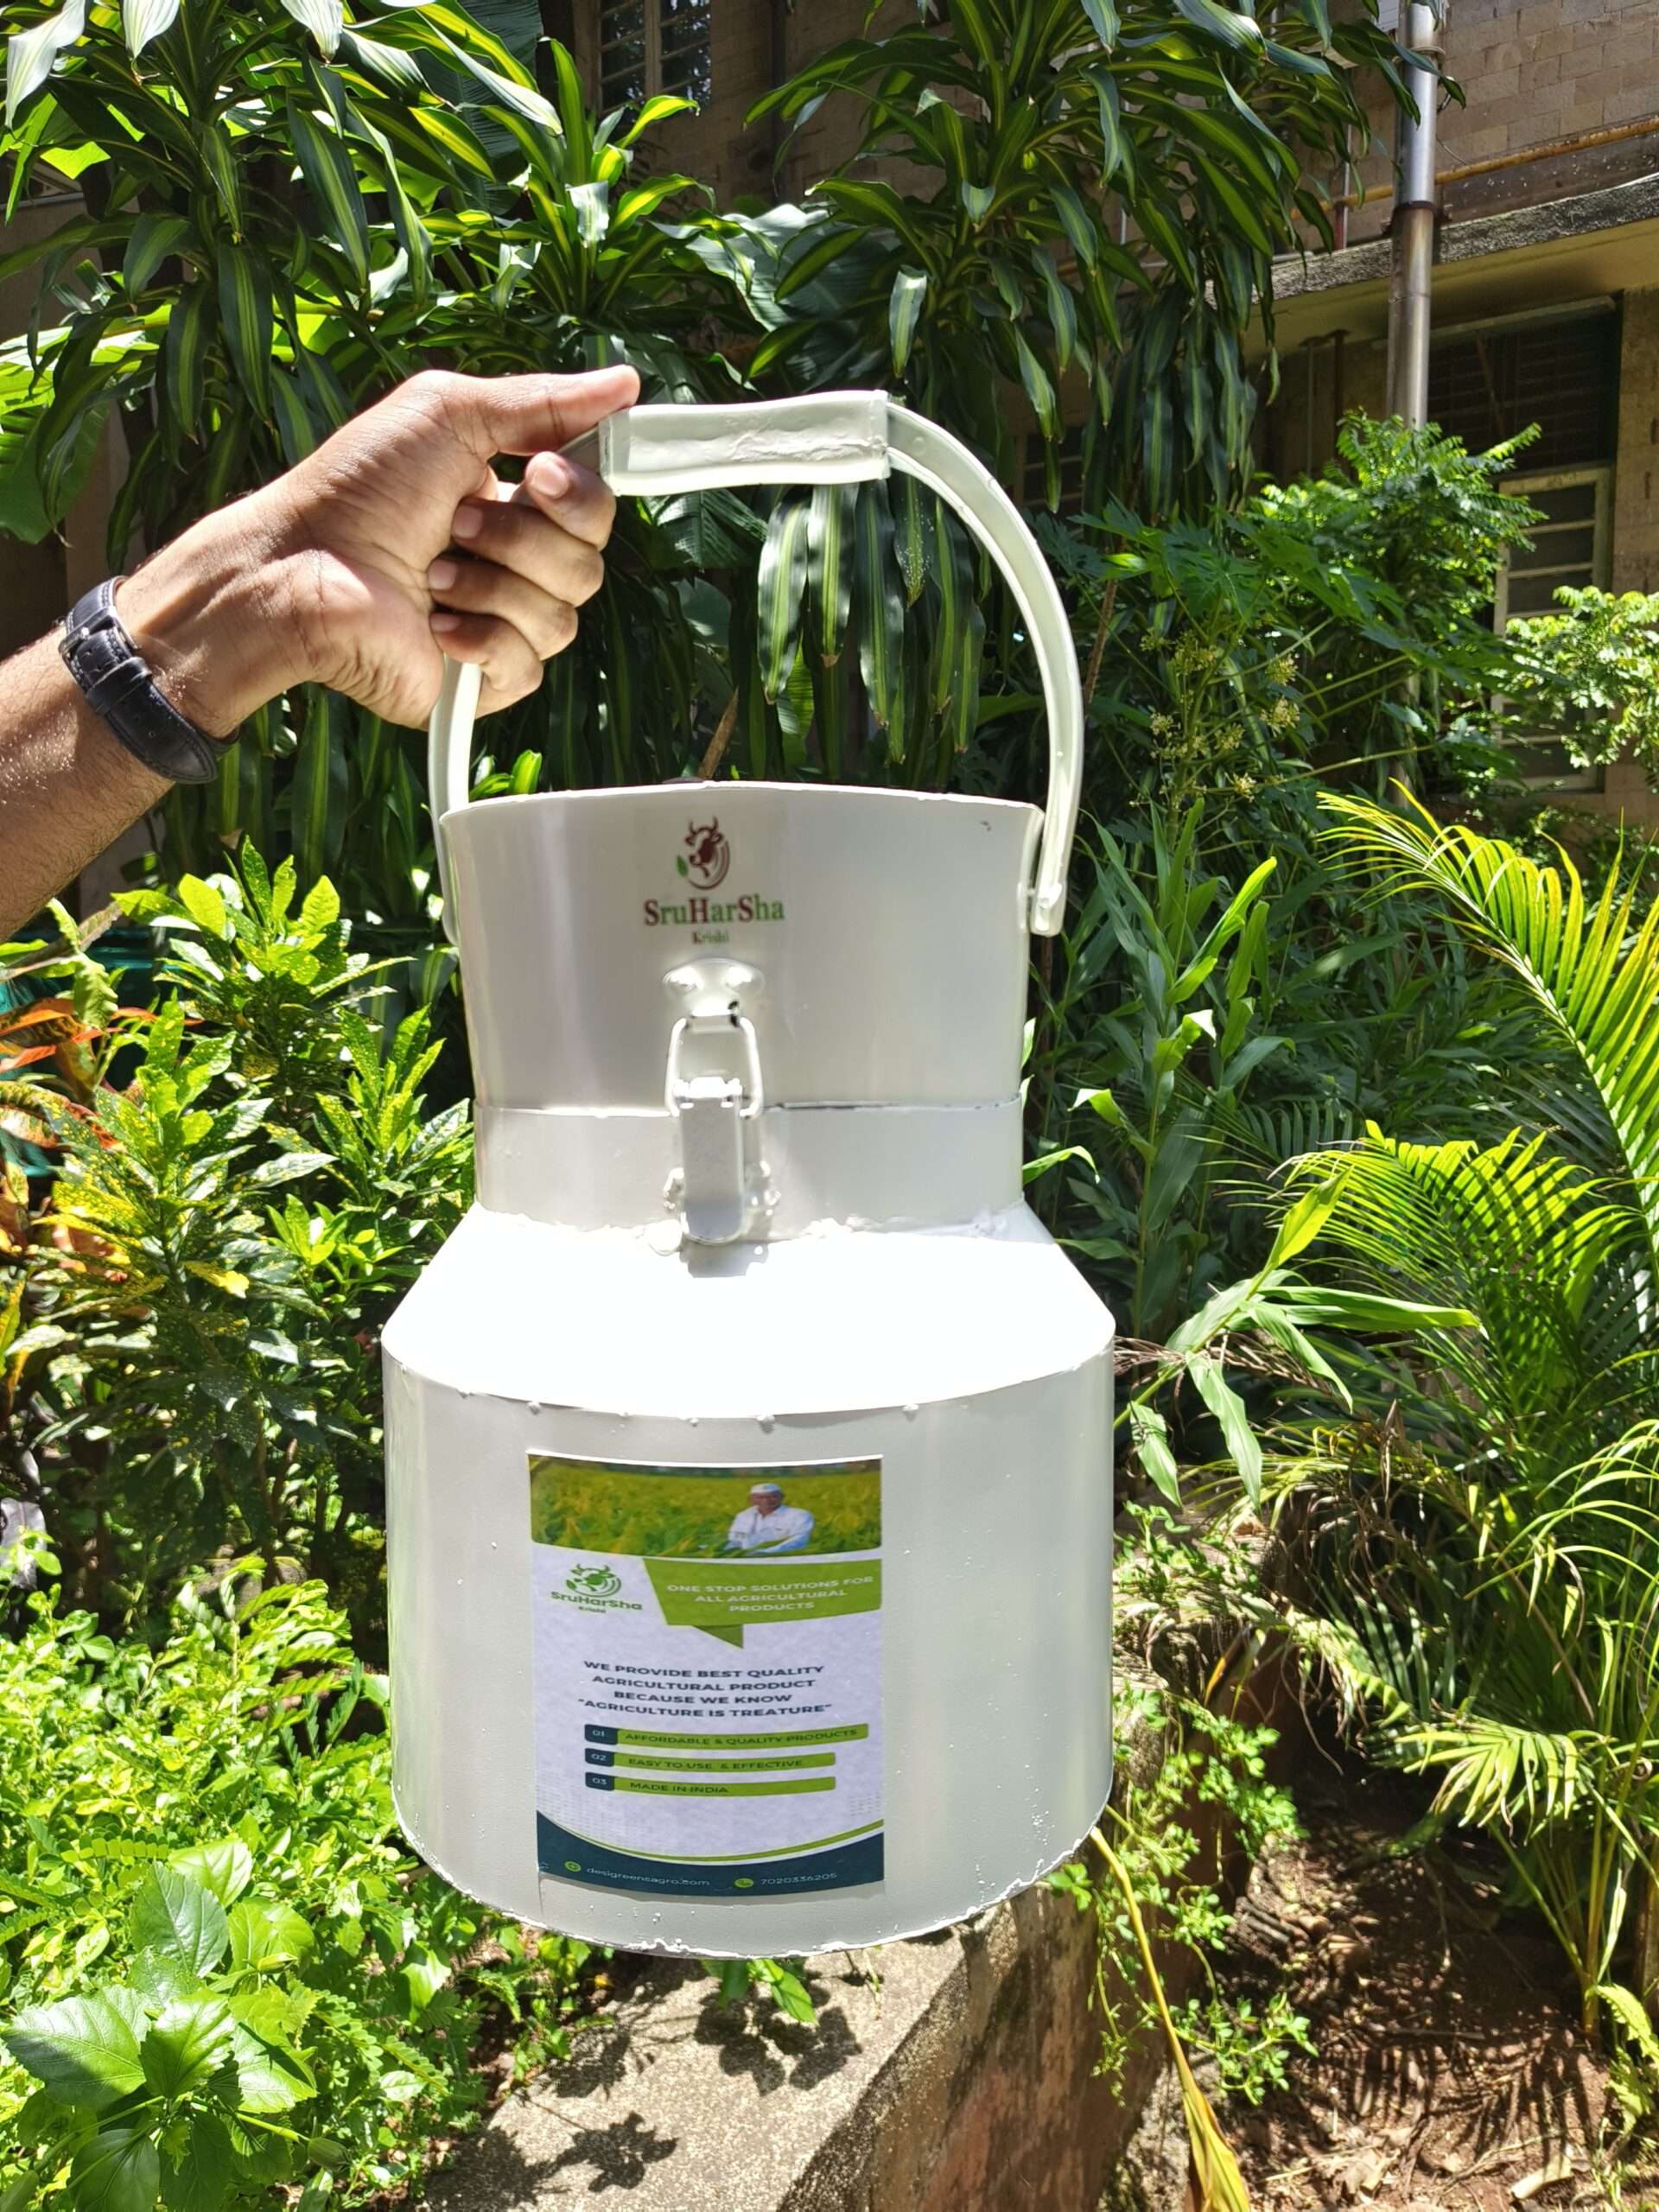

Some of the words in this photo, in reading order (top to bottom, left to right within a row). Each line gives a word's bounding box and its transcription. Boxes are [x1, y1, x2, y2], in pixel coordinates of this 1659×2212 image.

[643, 893, 785, 926] SruHarSha
[667, 1584, 700, 1592] ONE
[704, 1585, 747, 1593] STOP
[750, 1580, 839, 1592] SOLUTIONS
[842, 1575, 874, 1585] FOR
[550, 1591, 643, 1611] SruHarSha
[727, 1590, 848, 1603] AGRICULTURAL
[729, 1602, 815, 1611] PRODUCTS
[583, 1660, 610, 1671] WE
[615, 1665, 692, 1677] PROVIDE
[747, 1666, 824, 1678] QUALITY
[592, 1675, 725, 1691] AGRICULTURAL
[729, 1680, 816, 1691] PRODUCT
[614, 1691, 695, 1704] BECAUSE
[734, 1694, 792, 1704] KNOW
[626, 1733, 710, 1745] AFFORDABLE
[727, 1737, 783, 1745] QUALITY
[786, 1729, 858, 1742] PRODUCTS
[591, 1752, 607, 1761] 02
[629, 1758, 660, 1767] EASY
[733, 1759, 802, 1770] EFFECTIVE
[630, 1783, 669, 1792] MADE
[760, 1872, 837, 1885] 7020336205
